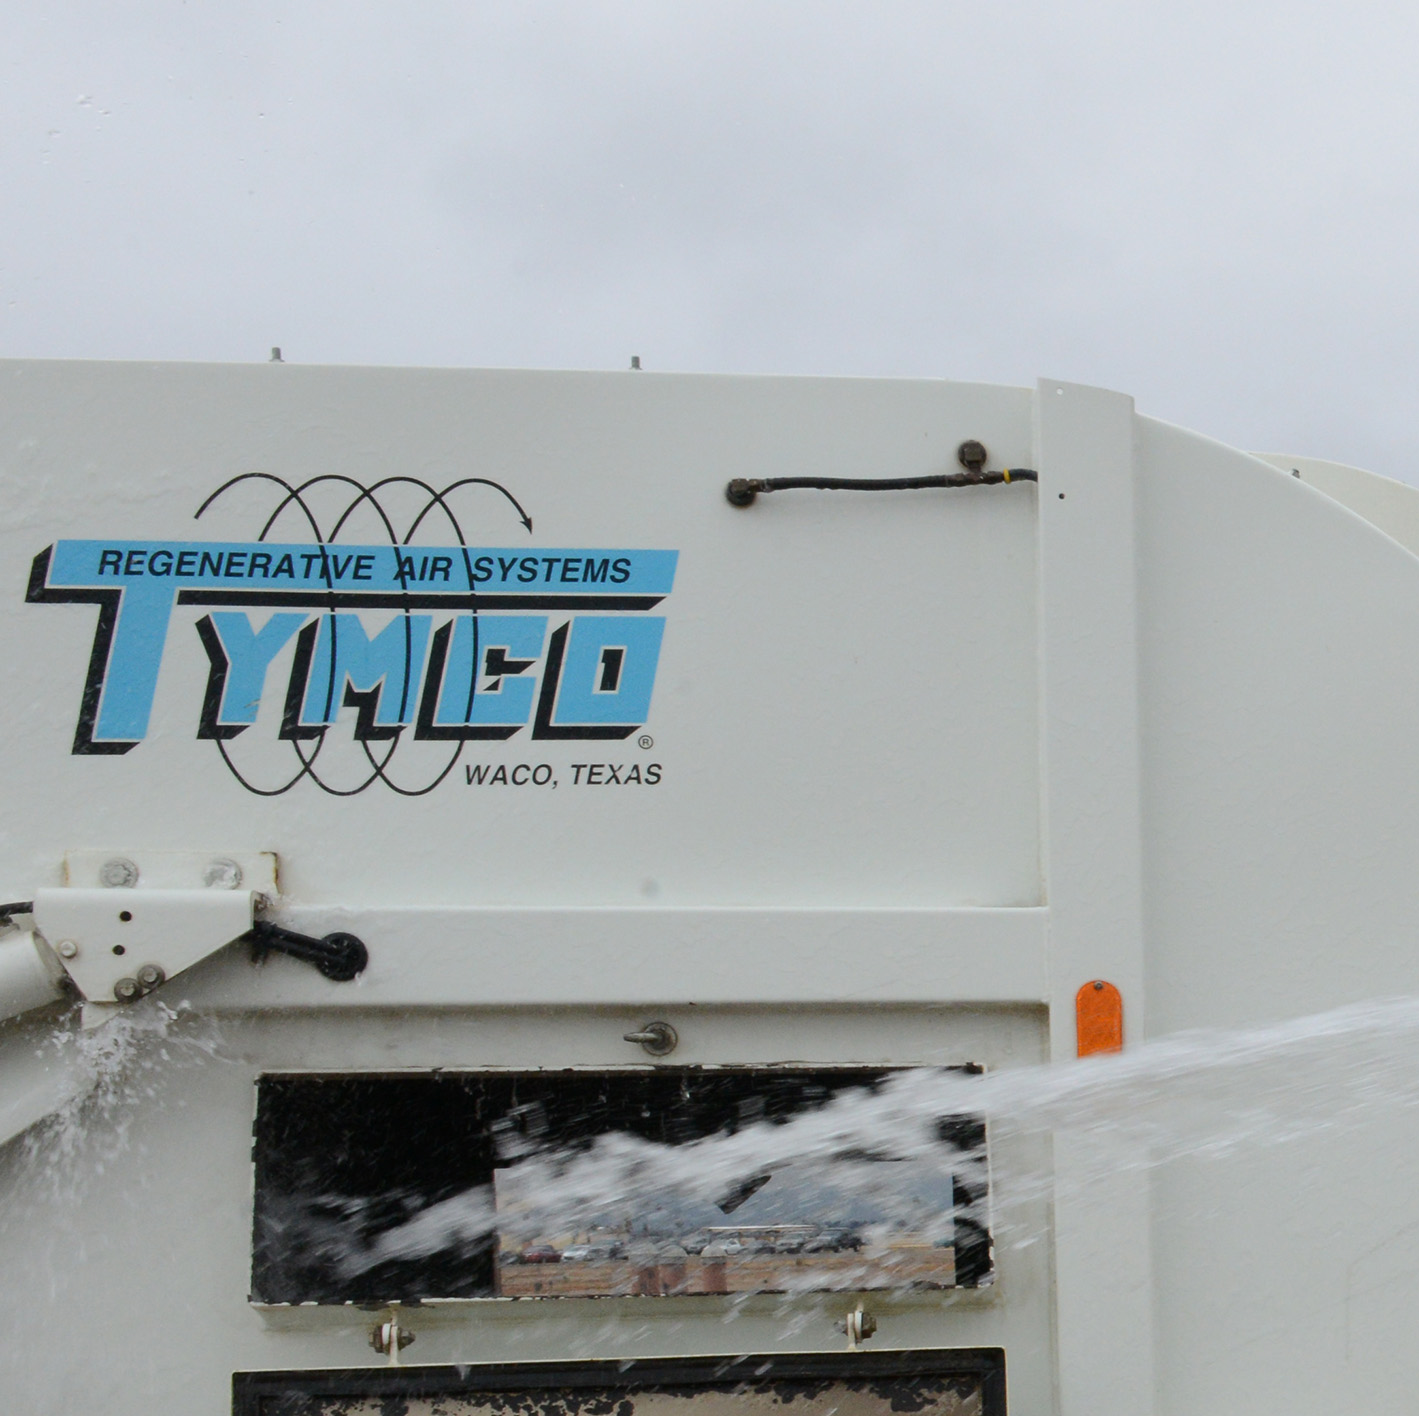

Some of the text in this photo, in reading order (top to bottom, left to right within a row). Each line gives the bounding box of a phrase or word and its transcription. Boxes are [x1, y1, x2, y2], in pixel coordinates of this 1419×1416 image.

[98, 549, 632, 584] REGENERATIVE AIR SYSTEMS
[25, 539, 680, 756] TYMCO
[464, 763, 663, 789] WACO, TEXAS
